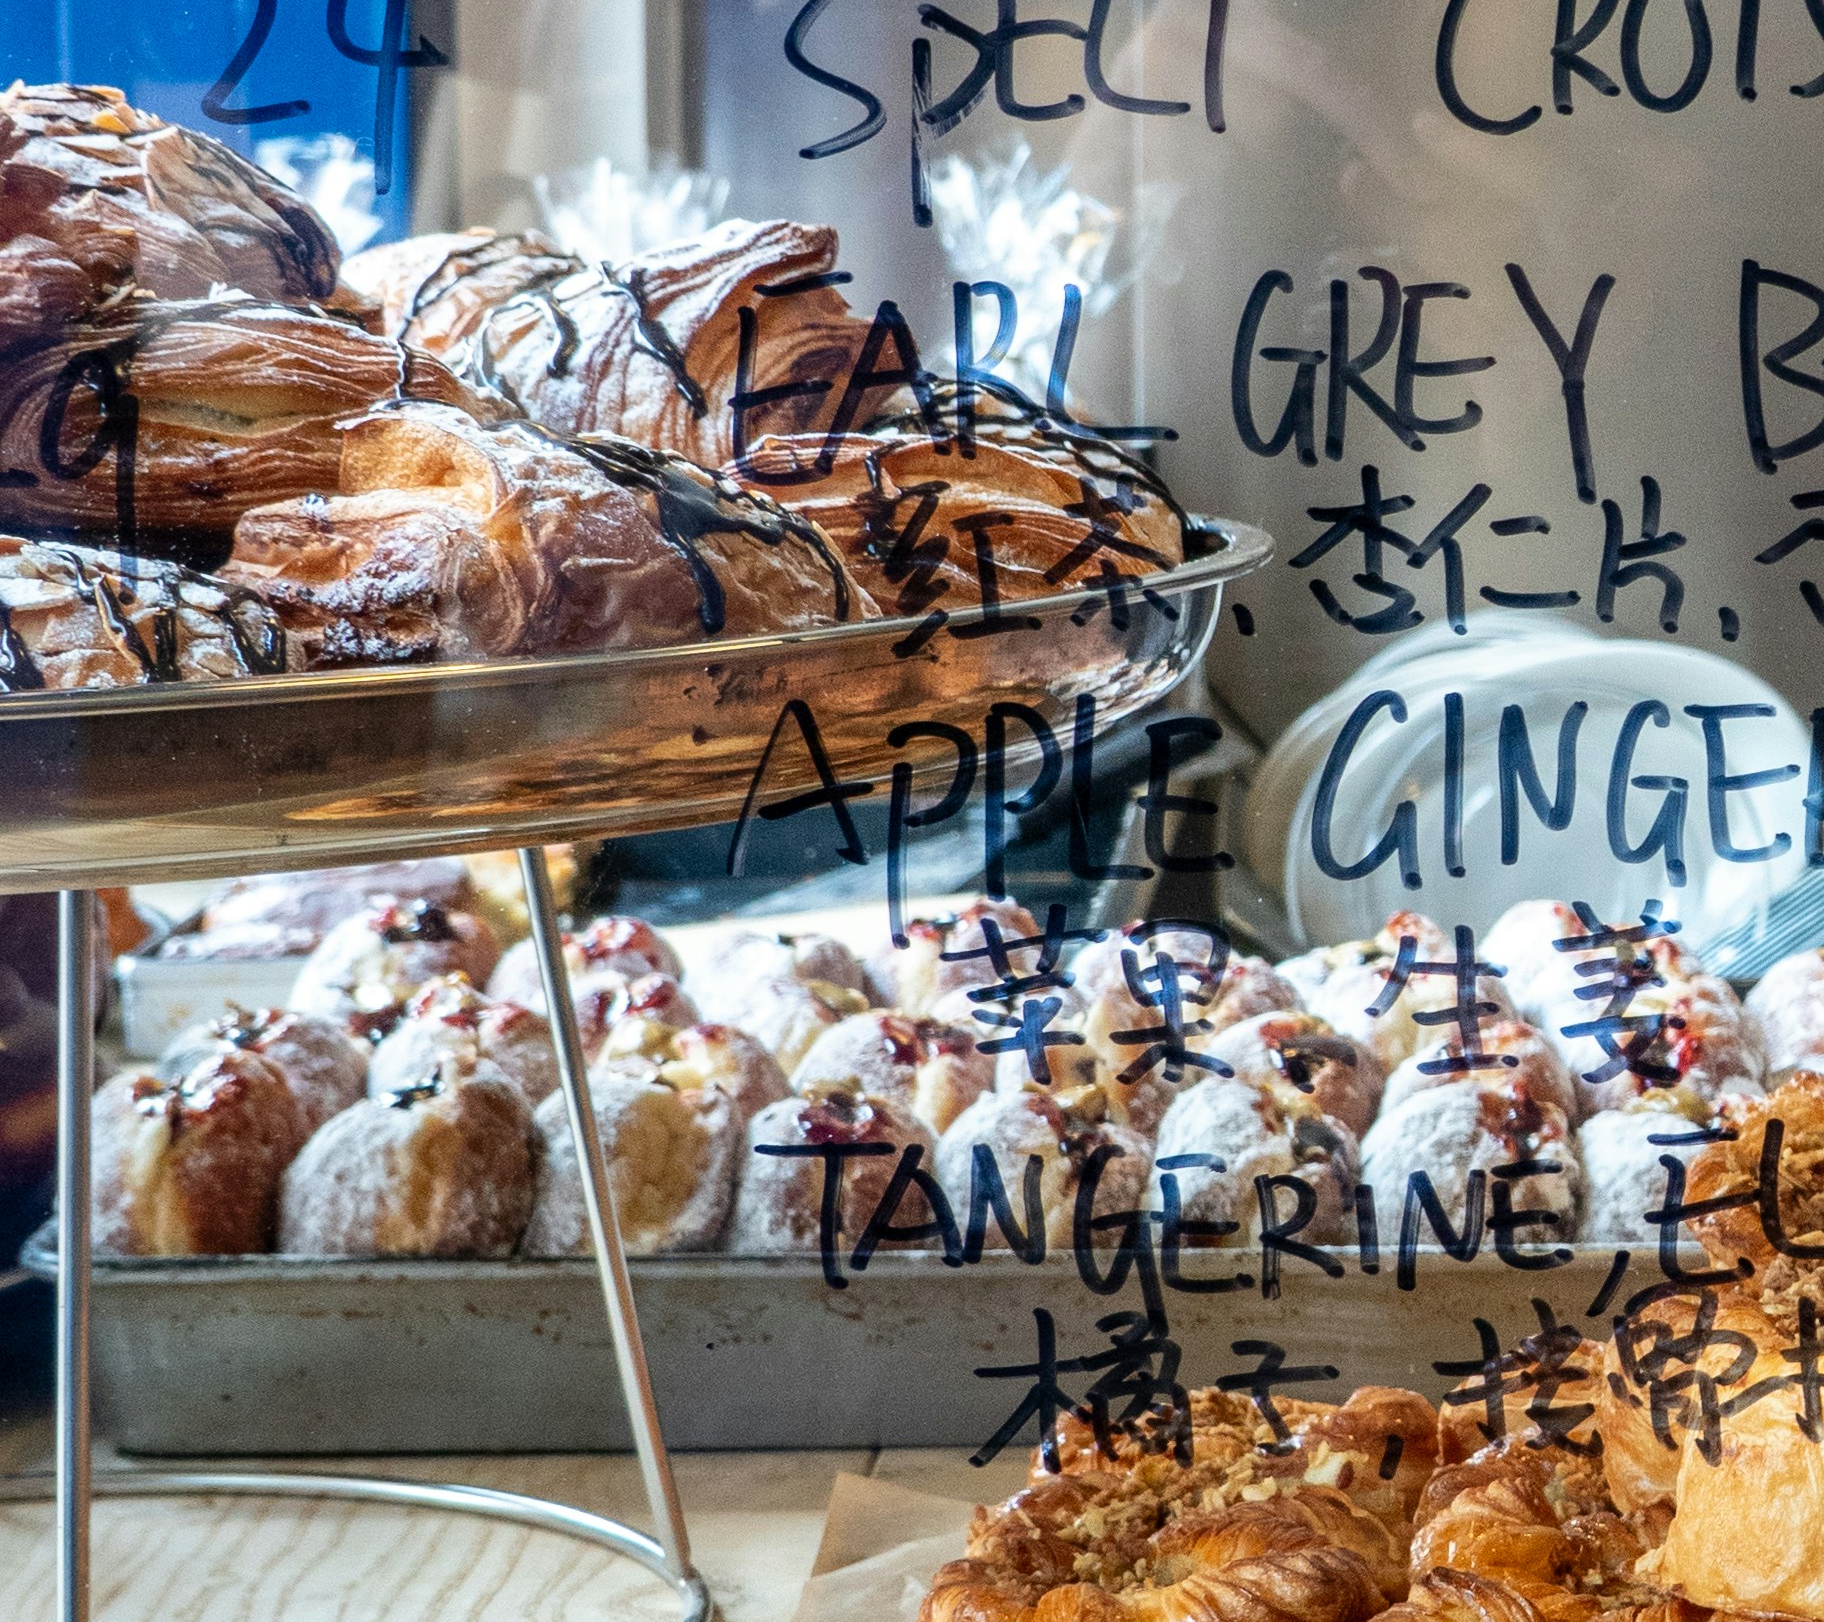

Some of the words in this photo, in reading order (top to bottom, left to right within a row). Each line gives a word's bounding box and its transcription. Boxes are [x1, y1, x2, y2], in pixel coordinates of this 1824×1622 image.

[727, 270, 1180, 485] EARL
[1231, 261, 1616, 504] GREY
[726, 693, 1235, 949] APPLE
